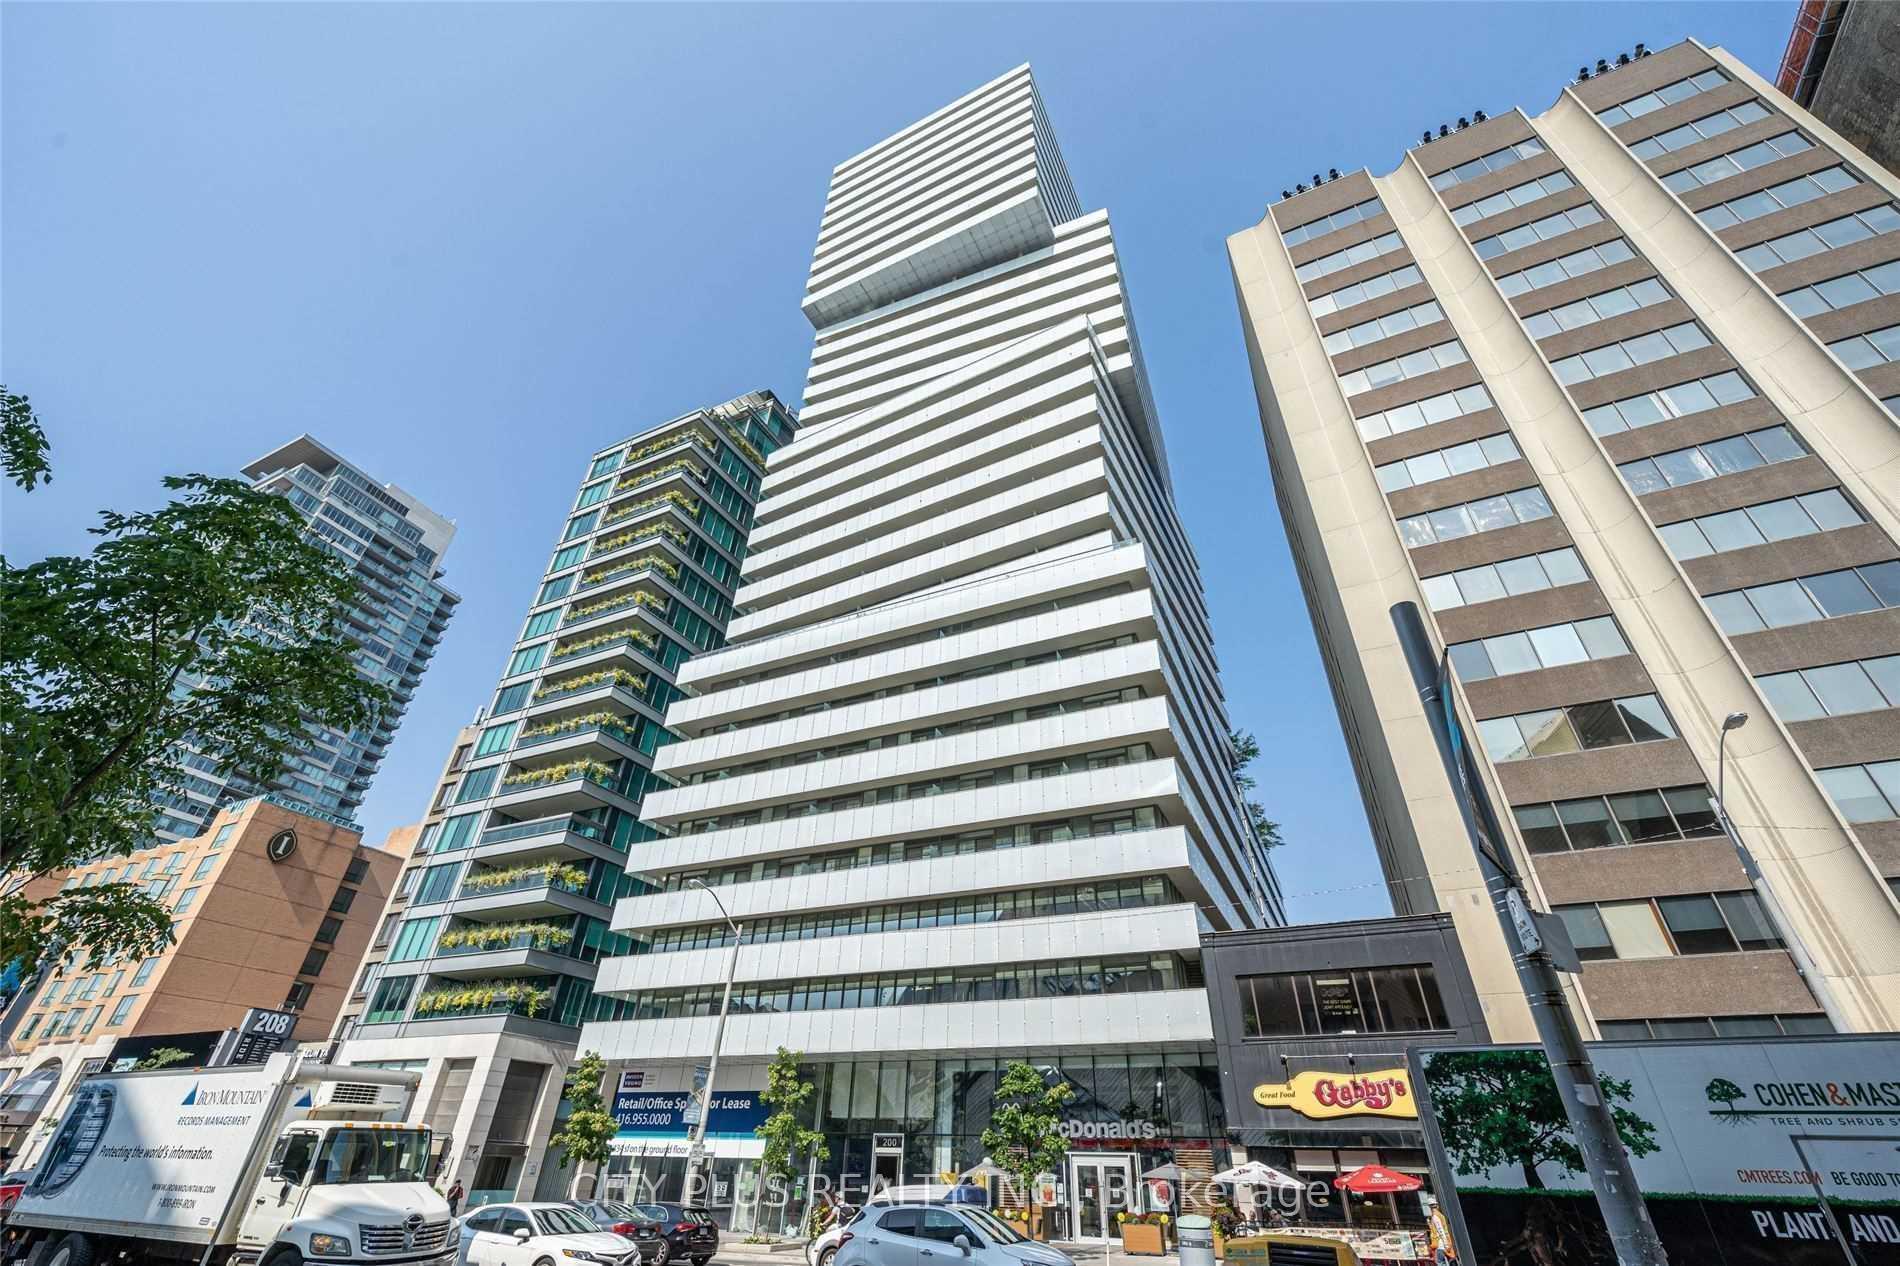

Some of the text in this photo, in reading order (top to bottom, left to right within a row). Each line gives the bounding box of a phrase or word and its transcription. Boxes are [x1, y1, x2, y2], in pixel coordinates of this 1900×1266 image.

[253, 1012, 290, 1034] 208
[1260, 1090, 1296, 1099] Great Food
[1313, 1078, 1407, 1109] Gabby's
[618, 1098, 674, 1109] Retail/Office
[711, 1099, 720, 1109] or
[722, 1097, 751, 1109] Lease
[178, 1115, 252, 1126] RECORDS MANAGEMENT
[1770, 1117, 1801, 1126] TREE
[1807, 1117, 1833, 1126] AND
[1838, 1117, 1885, 1127] SHRUB
[882, 1138, 897, 1147] 200
[98, 1145, 213, 1162] Protecting the world's information.
[649, 1144, 672, 1156] ground
[672, 1144, 689, 1154] floor
[1736, 1169, 1823, 1185] CMTREES.COM
[1830, 1171, 1850, 1186] BE
[1850, 1172, 1887, 1187] GOOD
[1848, 1213, 1900, 1244] AND
